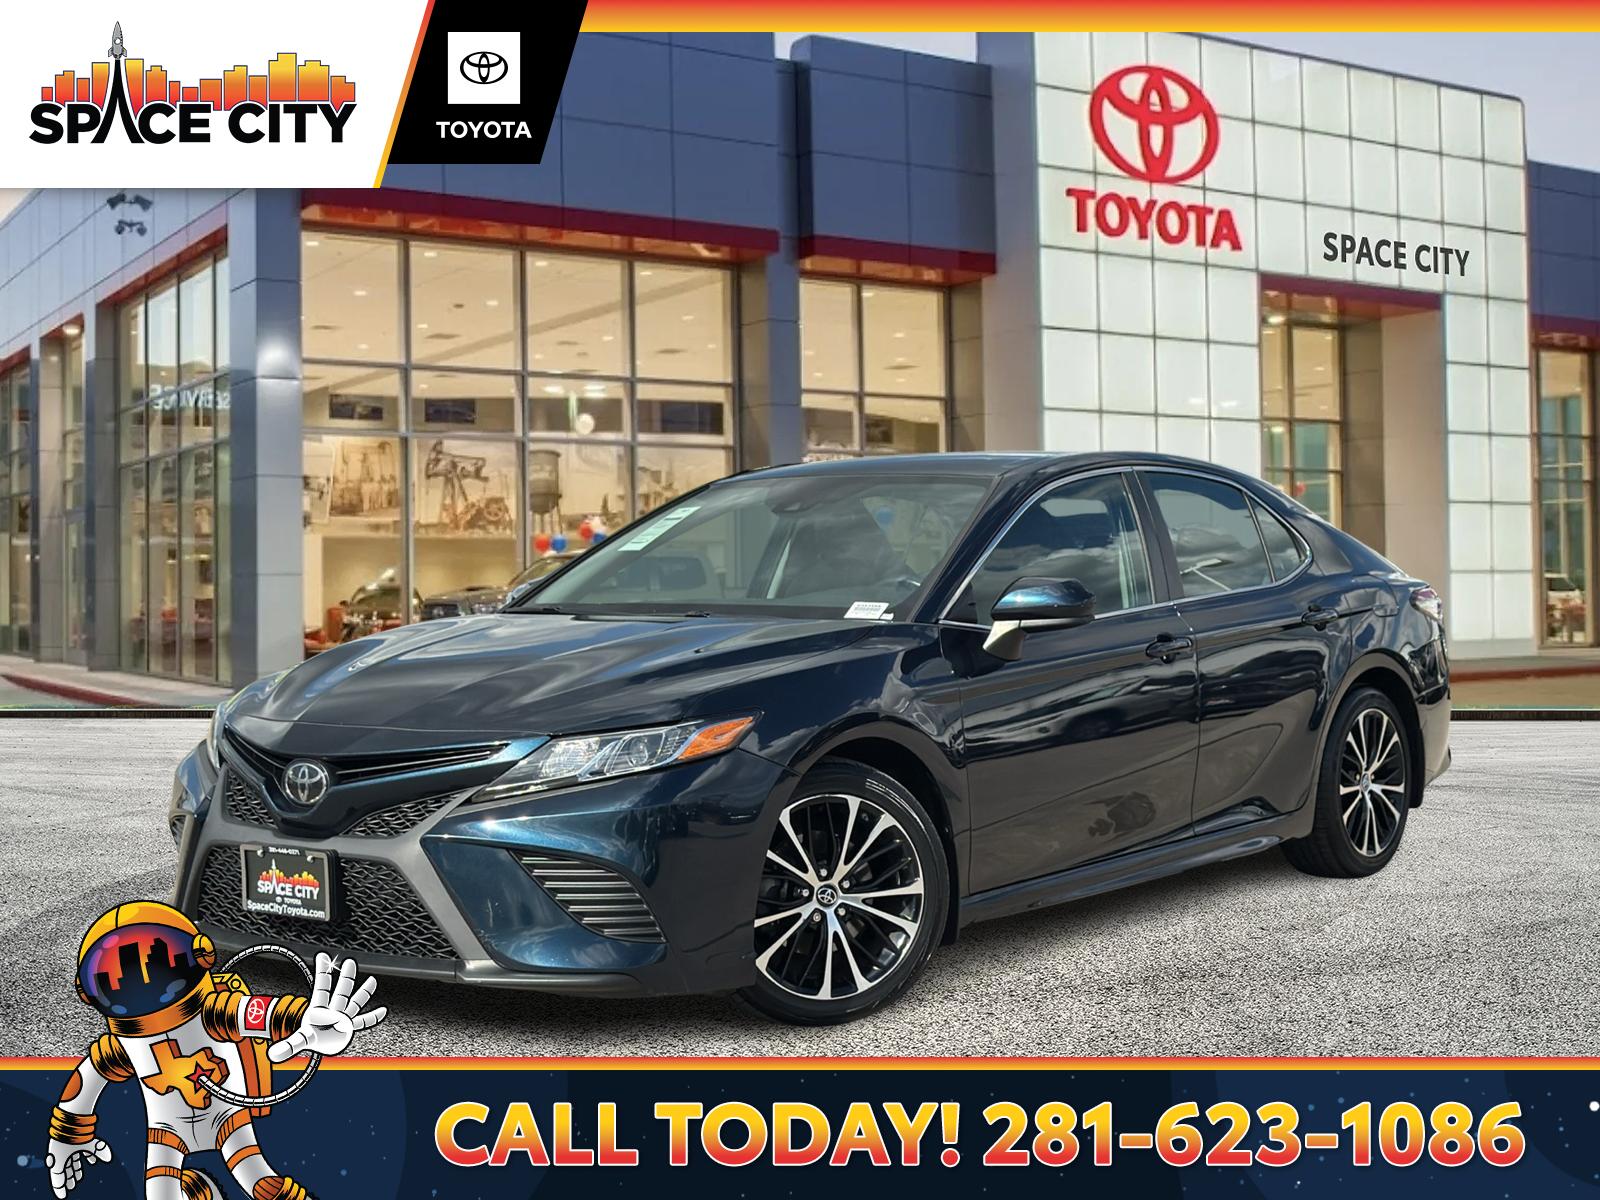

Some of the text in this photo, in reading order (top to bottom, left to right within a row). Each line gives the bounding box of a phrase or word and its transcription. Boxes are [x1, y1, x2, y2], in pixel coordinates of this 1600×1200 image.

[1066, 187, 1243, 252] TOYOTA
[1322, 231, 1471, 277] SPACE CITY
[294, 884, 320, 900] CITY
[246, 899, 326, 919] SpaceCityToyota.com
